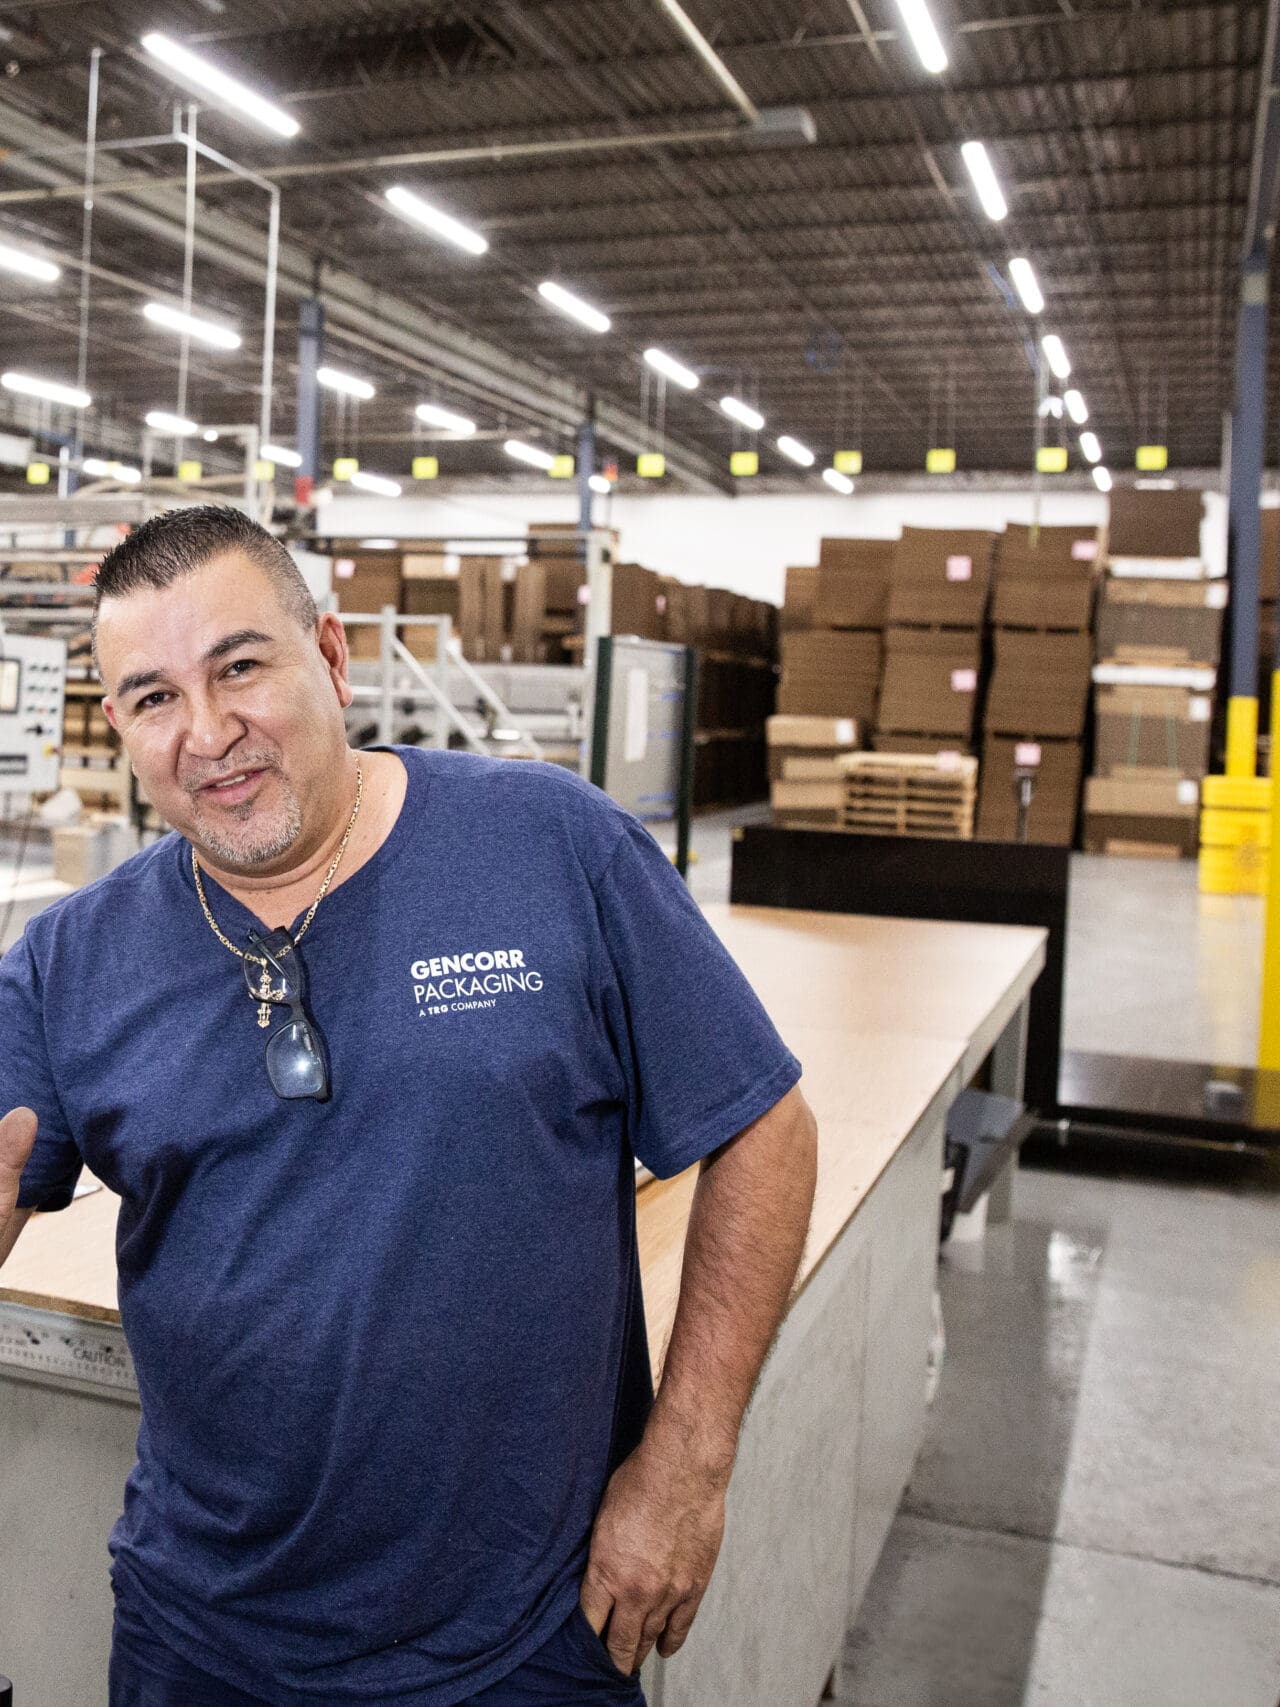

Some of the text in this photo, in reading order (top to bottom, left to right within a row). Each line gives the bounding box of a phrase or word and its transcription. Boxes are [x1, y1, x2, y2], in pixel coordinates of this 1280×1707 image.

[411, 949, 526, 980] GENCORR
[413, 971, 544, 1004] PACKAGING
[419, 999, 497, 1017] A TRG COMPANY
